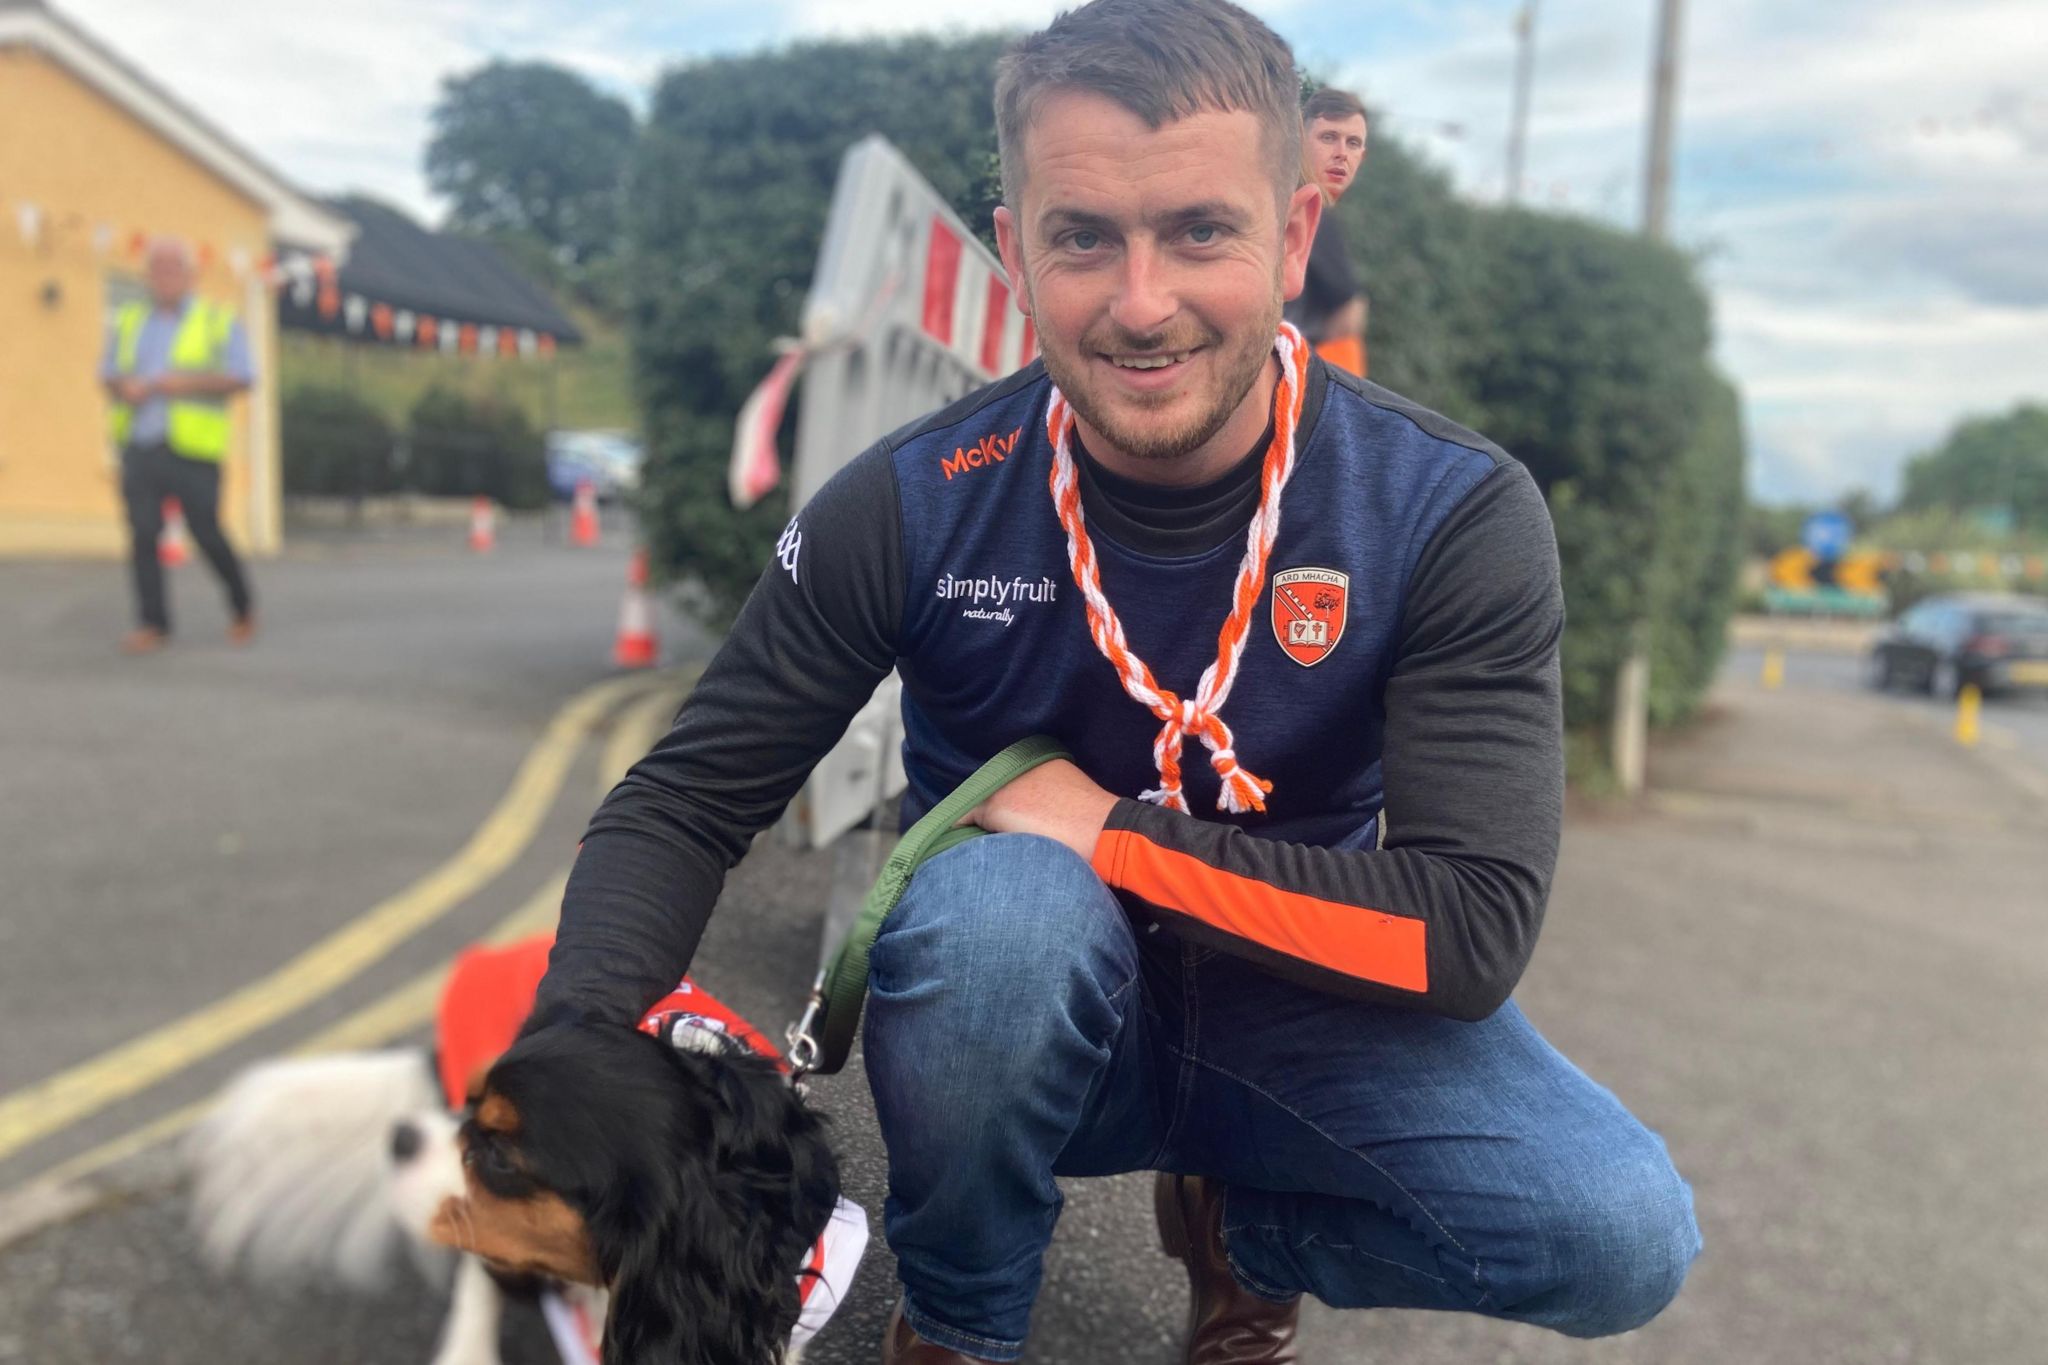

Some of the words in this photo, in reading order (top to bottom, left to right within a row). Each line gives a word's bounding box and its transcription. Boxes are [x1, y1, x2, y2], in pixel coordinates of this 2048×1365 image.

[1281, 573, 1299, 583] ARD
[1302, 572, 1339, 584] MHACHA
[963, 608, 1015, 627] naturally
